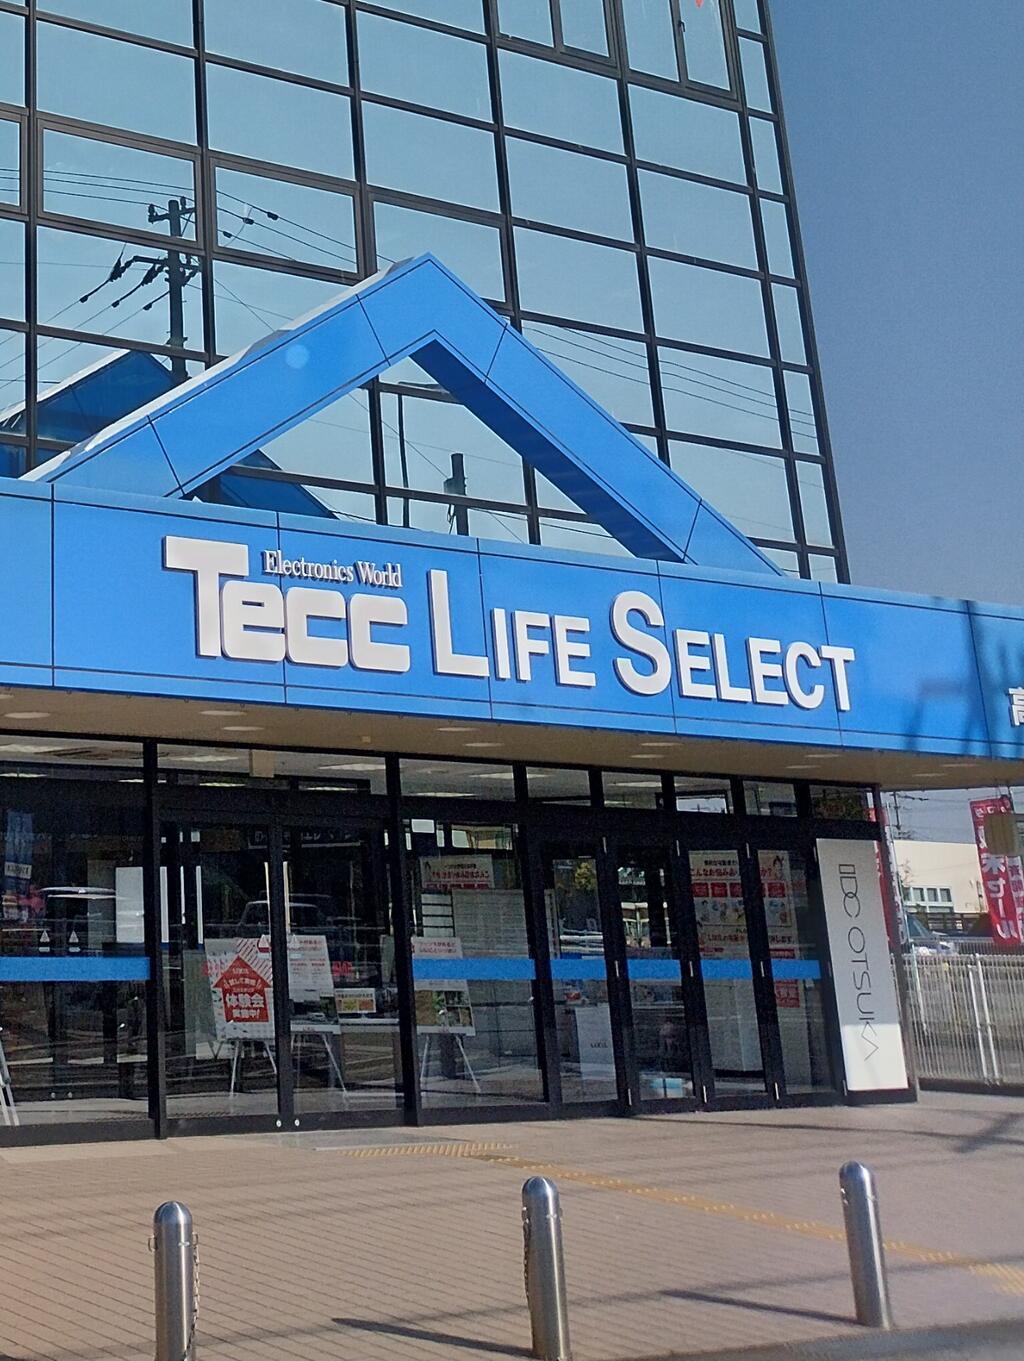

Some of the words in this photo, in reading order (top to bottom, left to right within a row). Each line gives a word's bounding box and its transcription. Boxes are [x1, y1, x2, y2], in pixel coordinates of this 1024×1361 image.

[264, 549, 354, 582] Electronics
[356, 560, 403, 588] World
[427, 568, 597, 689] LIFE
[610, 590, 856, 713] SELECT
[225, 993, 265, 1008] 体験会
[847, 926, 880, 1062] OTSUKA
